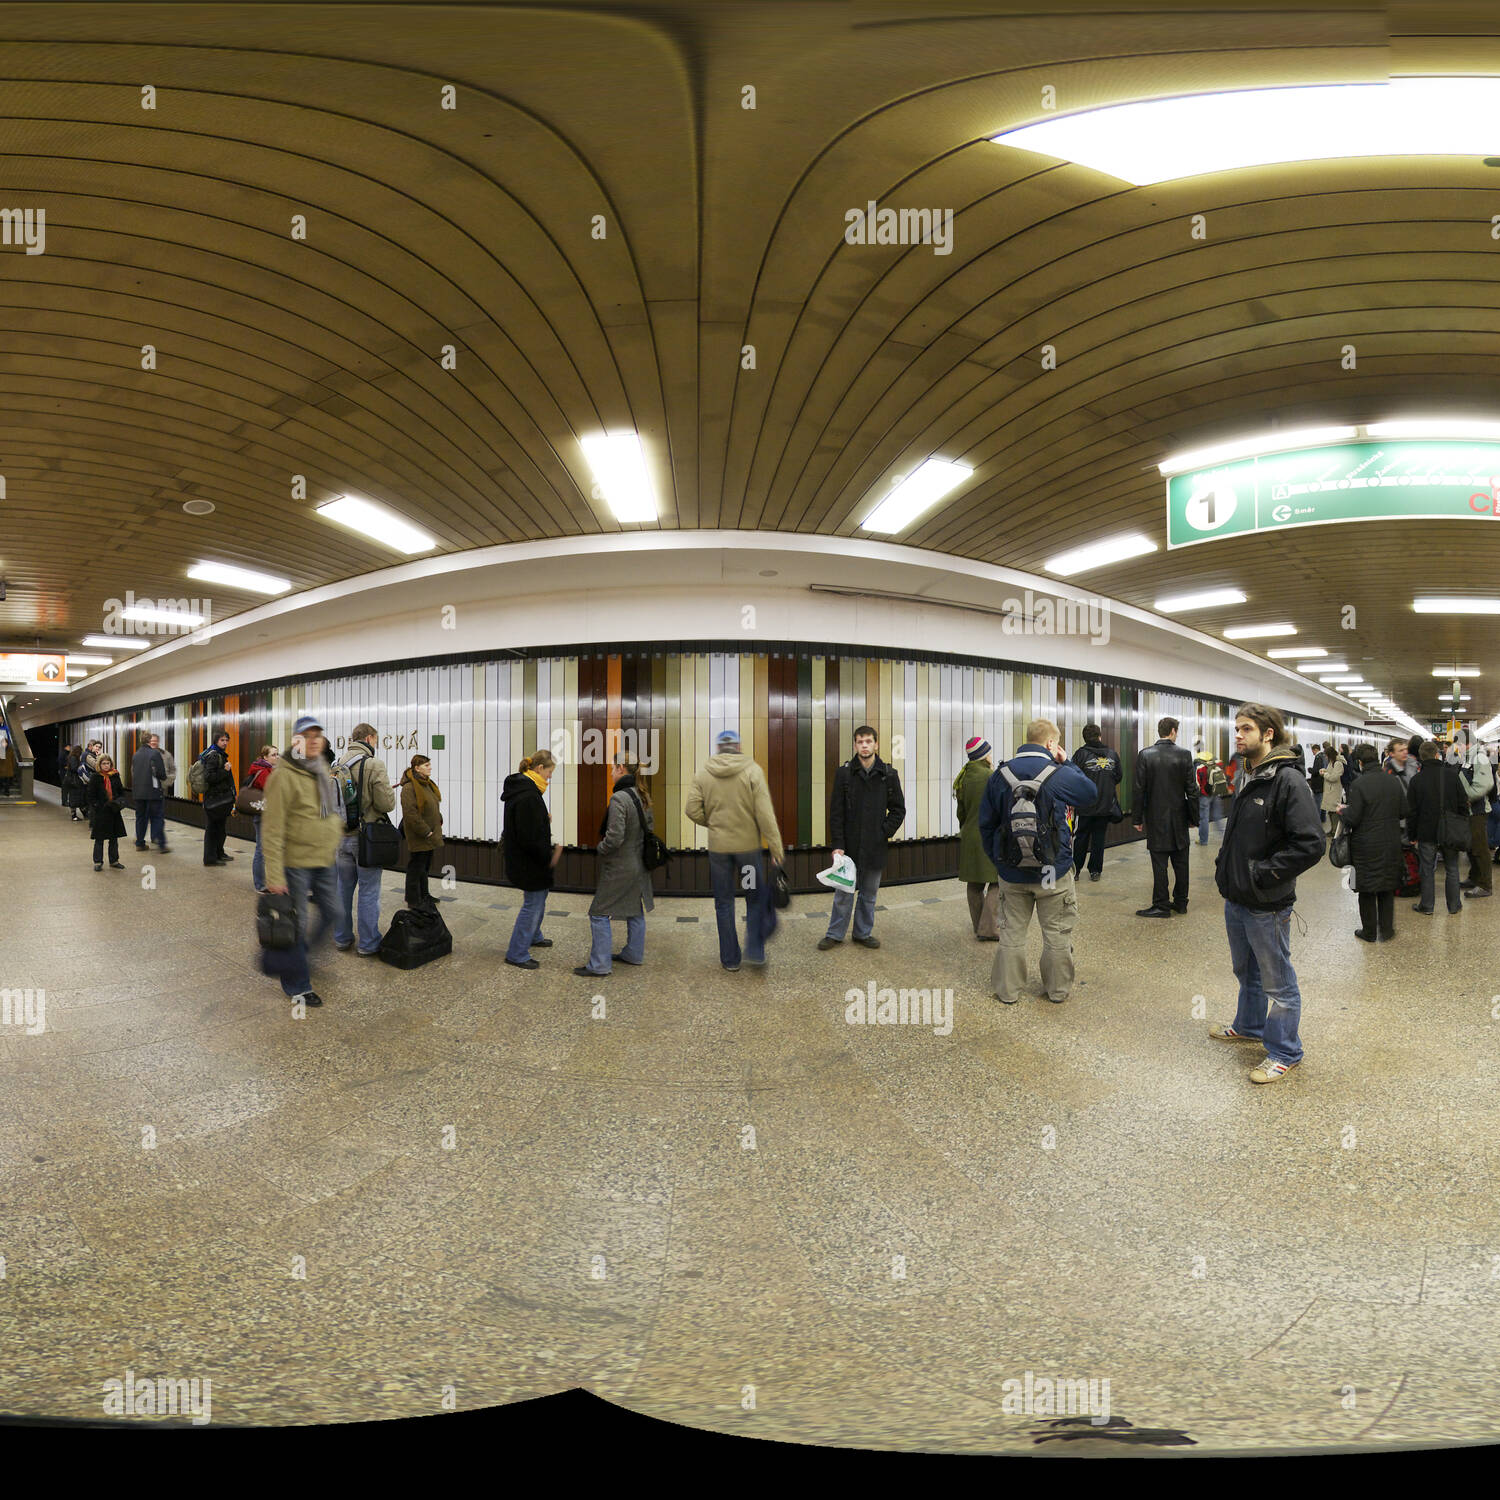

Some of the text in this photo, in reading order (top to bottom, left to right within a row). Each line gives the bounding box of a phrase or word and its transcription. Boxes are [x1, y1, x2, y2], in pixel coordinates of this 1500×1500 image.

[1275, 485, 1288, 498] A
[1199, 491, 1216, 524] 1
[1469, 492, 1490, 512] C
[336, 730, 419, 750] DICKÁ
